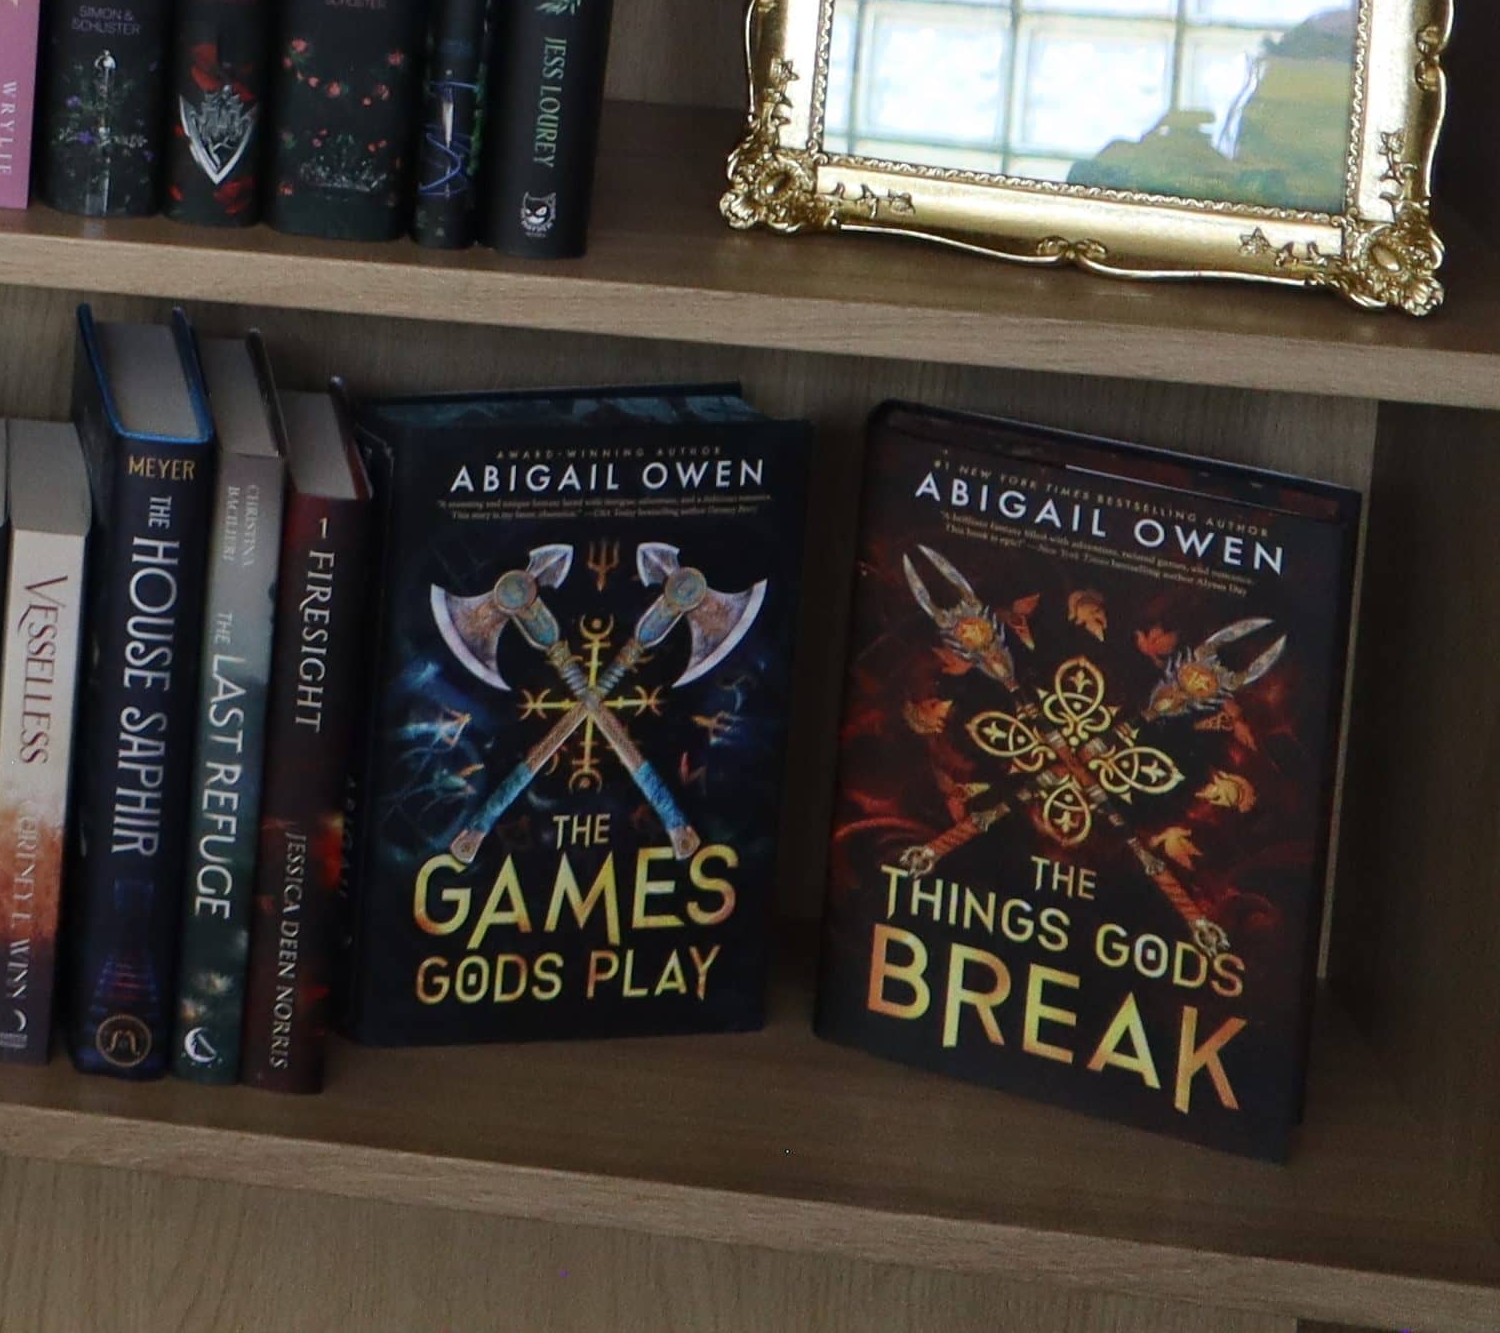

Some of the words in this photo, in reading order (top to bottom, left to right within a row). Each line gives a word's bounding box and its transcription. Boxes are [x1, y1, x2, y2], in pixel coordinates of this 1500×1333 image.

[126, 454, 197, 483] MEYER
[449, 460, 624, 496] ABIGAIL
[641, 458, 769, 493] OWEN
[413, 843, 741, 952] GAMES
[416, 952, 562, 1007] GODS
[586, 947, 720, 1002] PLAY
[865, 921, 1250, 1117] BREAK
